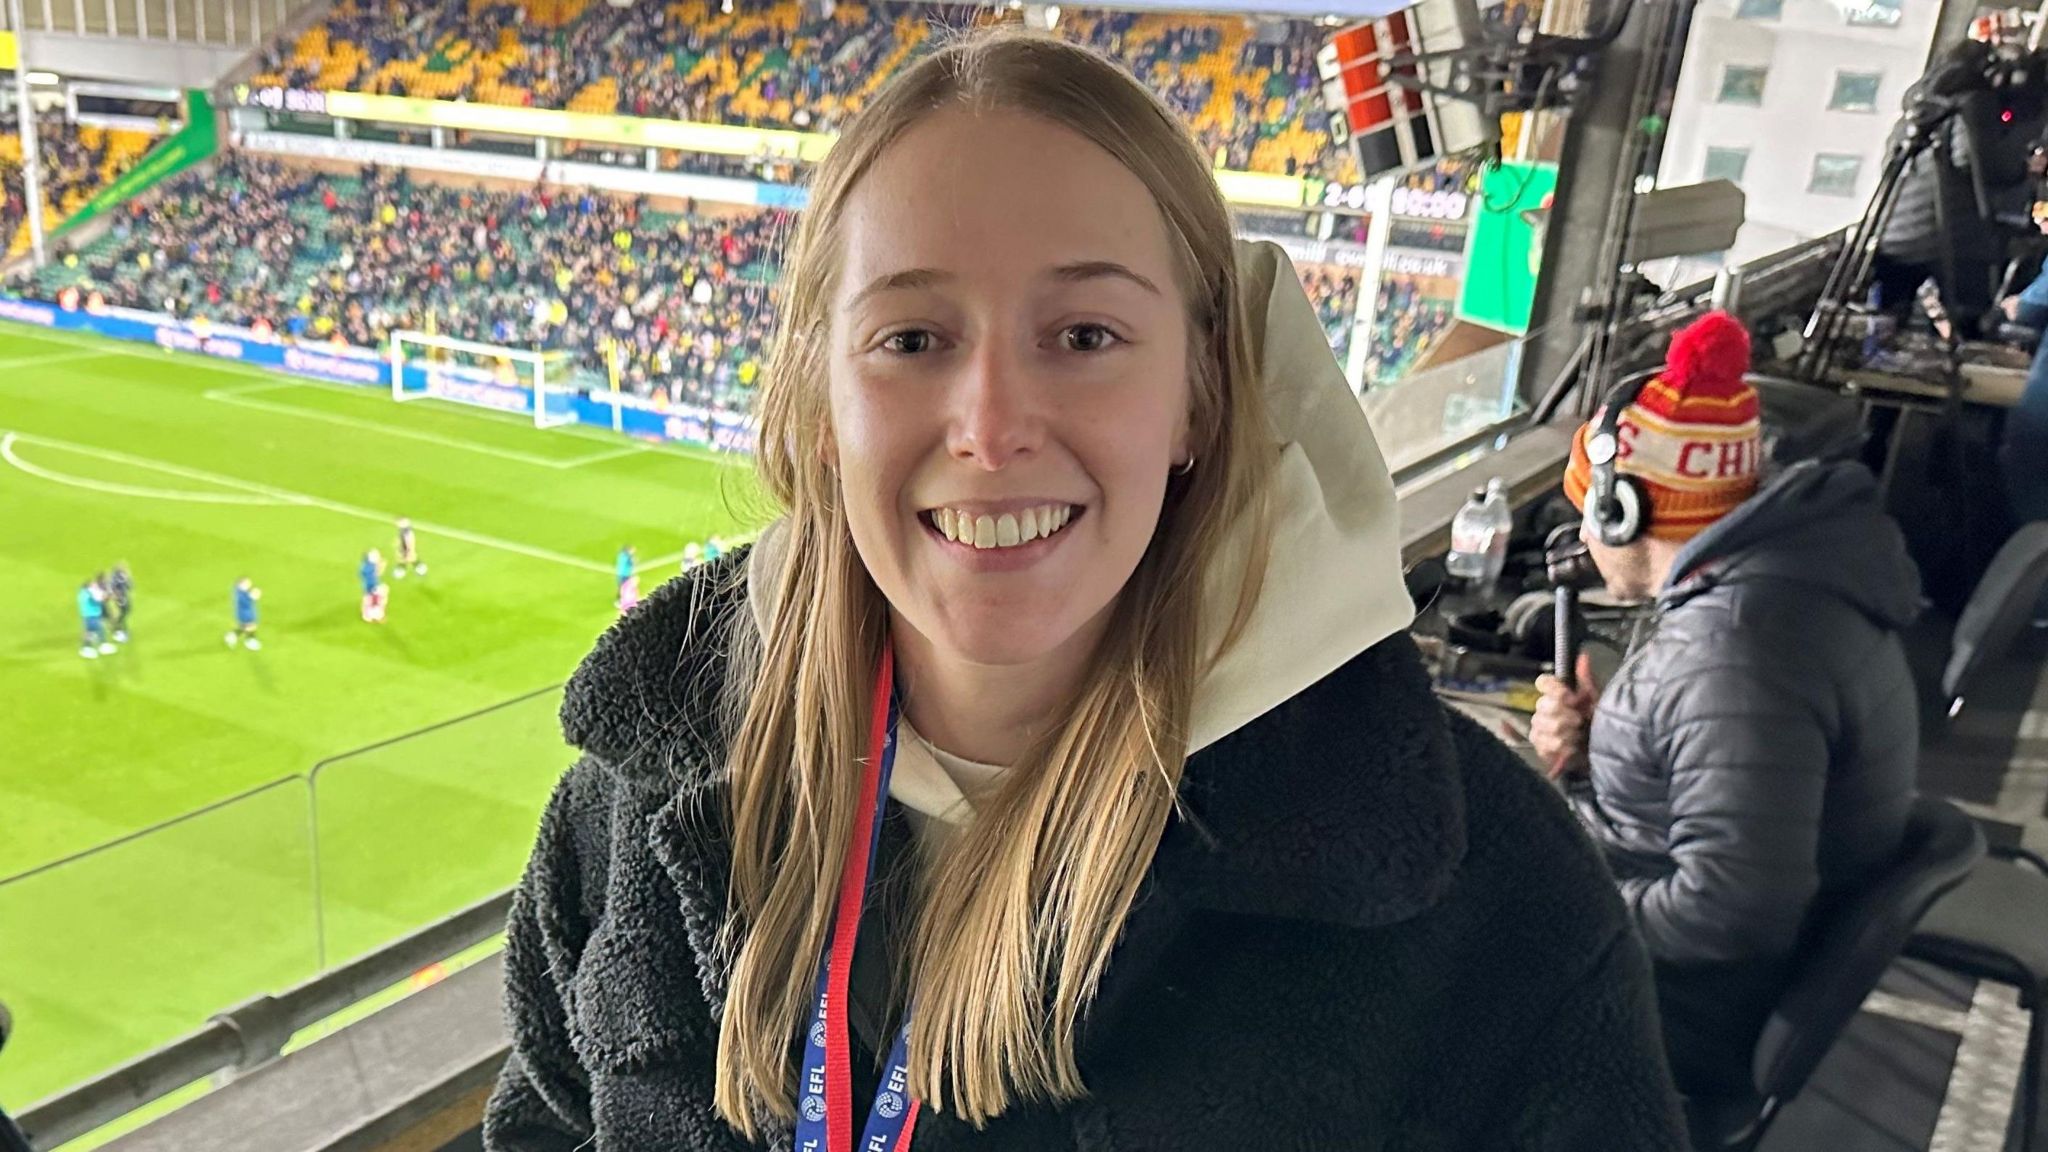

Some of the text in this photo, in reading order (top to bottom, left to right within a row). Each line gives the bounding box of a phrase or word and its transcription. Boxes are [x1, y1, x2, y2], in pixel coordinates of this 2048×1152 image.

[808, 1065, 825, 1095] EFL
[887, 1065, 909, 1093] EFL
[867, 1134, 887, 1152] FL
